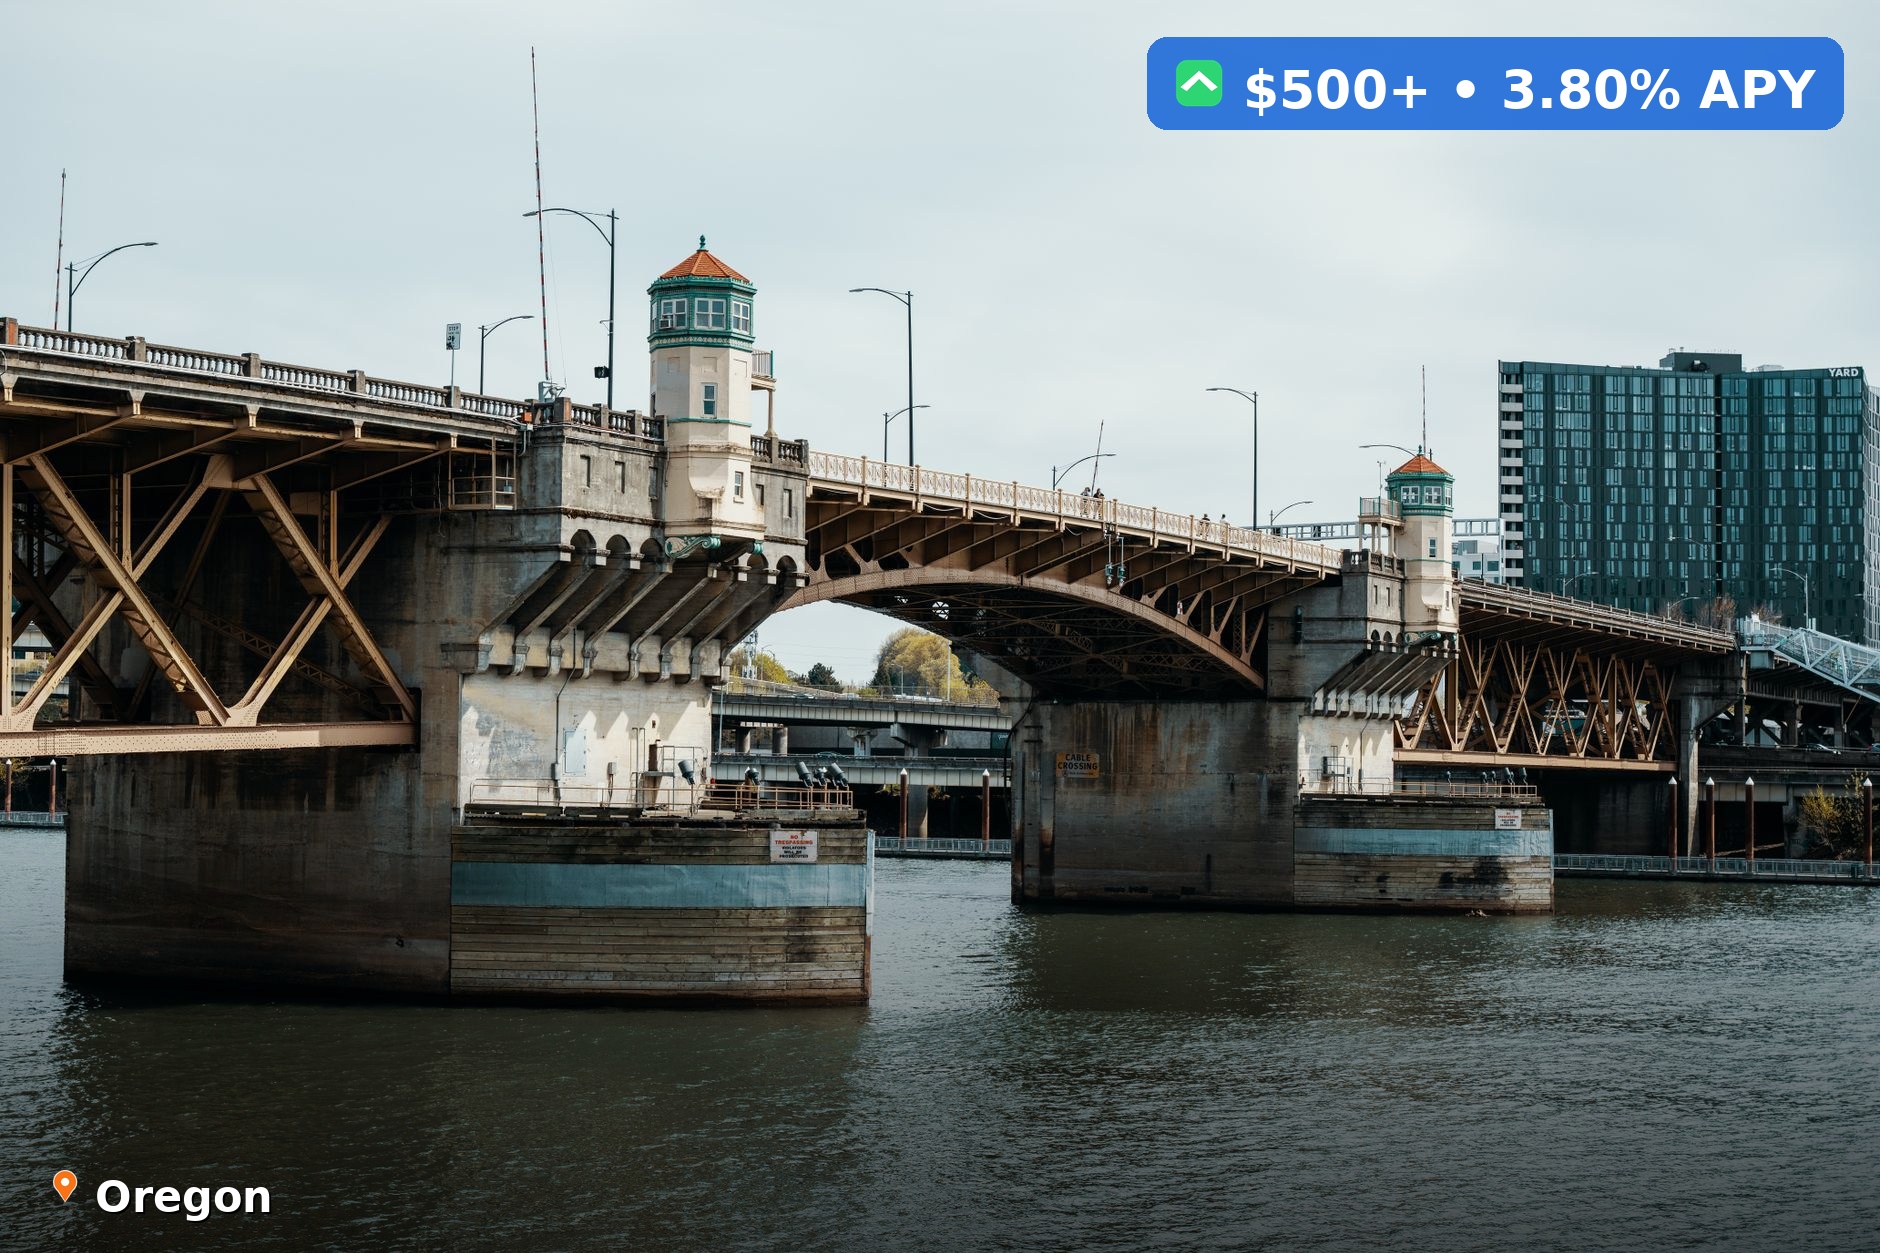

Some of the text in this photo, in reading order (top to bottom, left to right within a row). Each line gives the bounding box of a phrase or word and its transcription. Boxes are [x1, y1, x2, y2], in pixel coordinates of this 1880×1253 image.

[1828, 367, 1859, 377] YARD
[1065, 753, 1091, 762] CABLE
[1057, 761, 1098, 770] CROSSING
